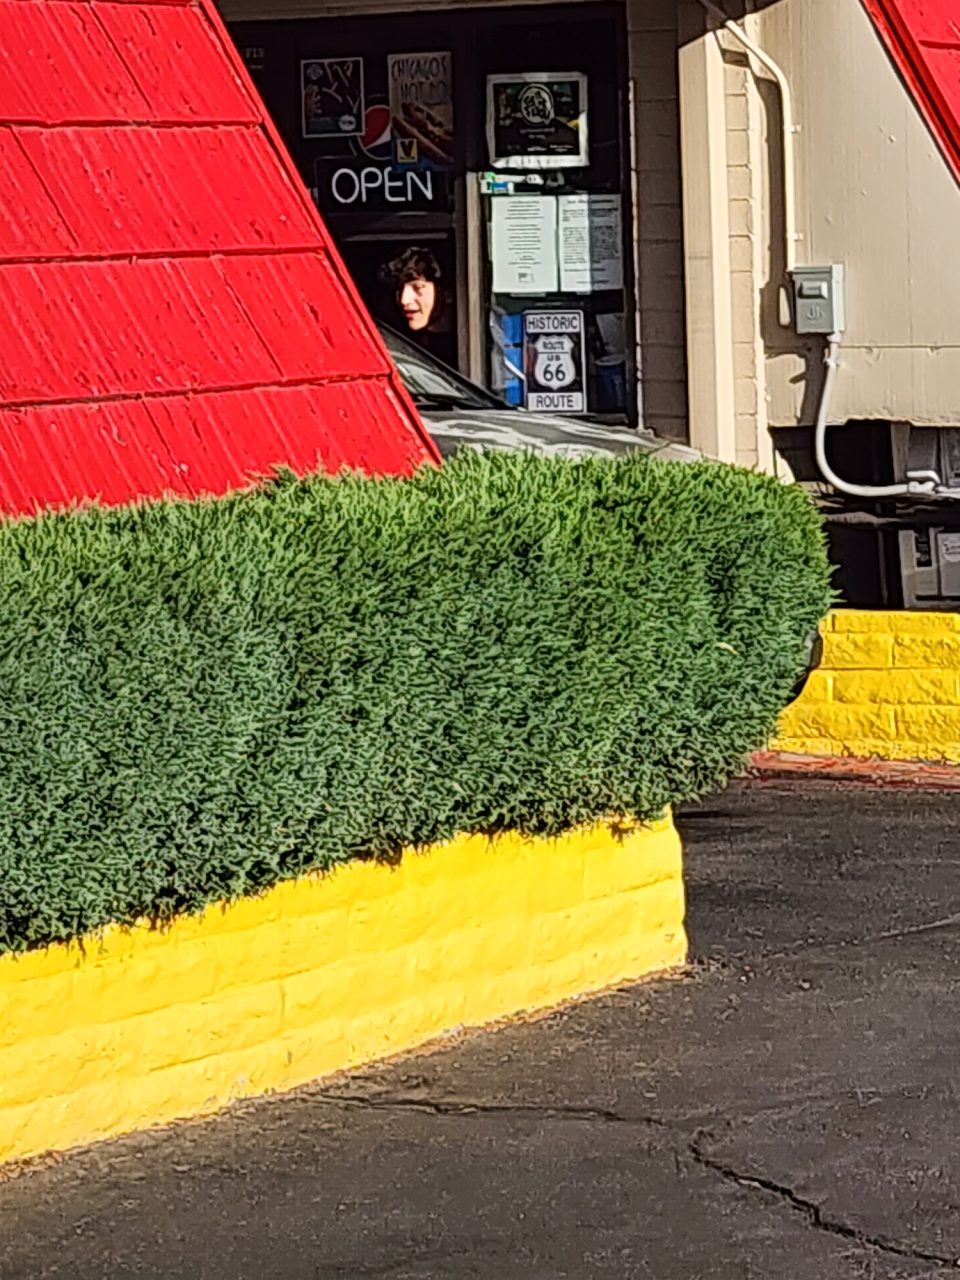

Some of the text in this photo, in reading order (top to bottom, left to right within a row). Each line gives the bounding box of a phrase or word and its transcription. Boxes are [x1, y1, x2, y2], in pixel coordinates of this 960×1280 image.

[331, 167, 433, 203] OPEN
[528, 316, 577, 329] HISTORIC
[543, 341, 565, 350] ROUTE
[543, 363, 566, 382] 66
[536, 394, 575, 408] ROUTE
